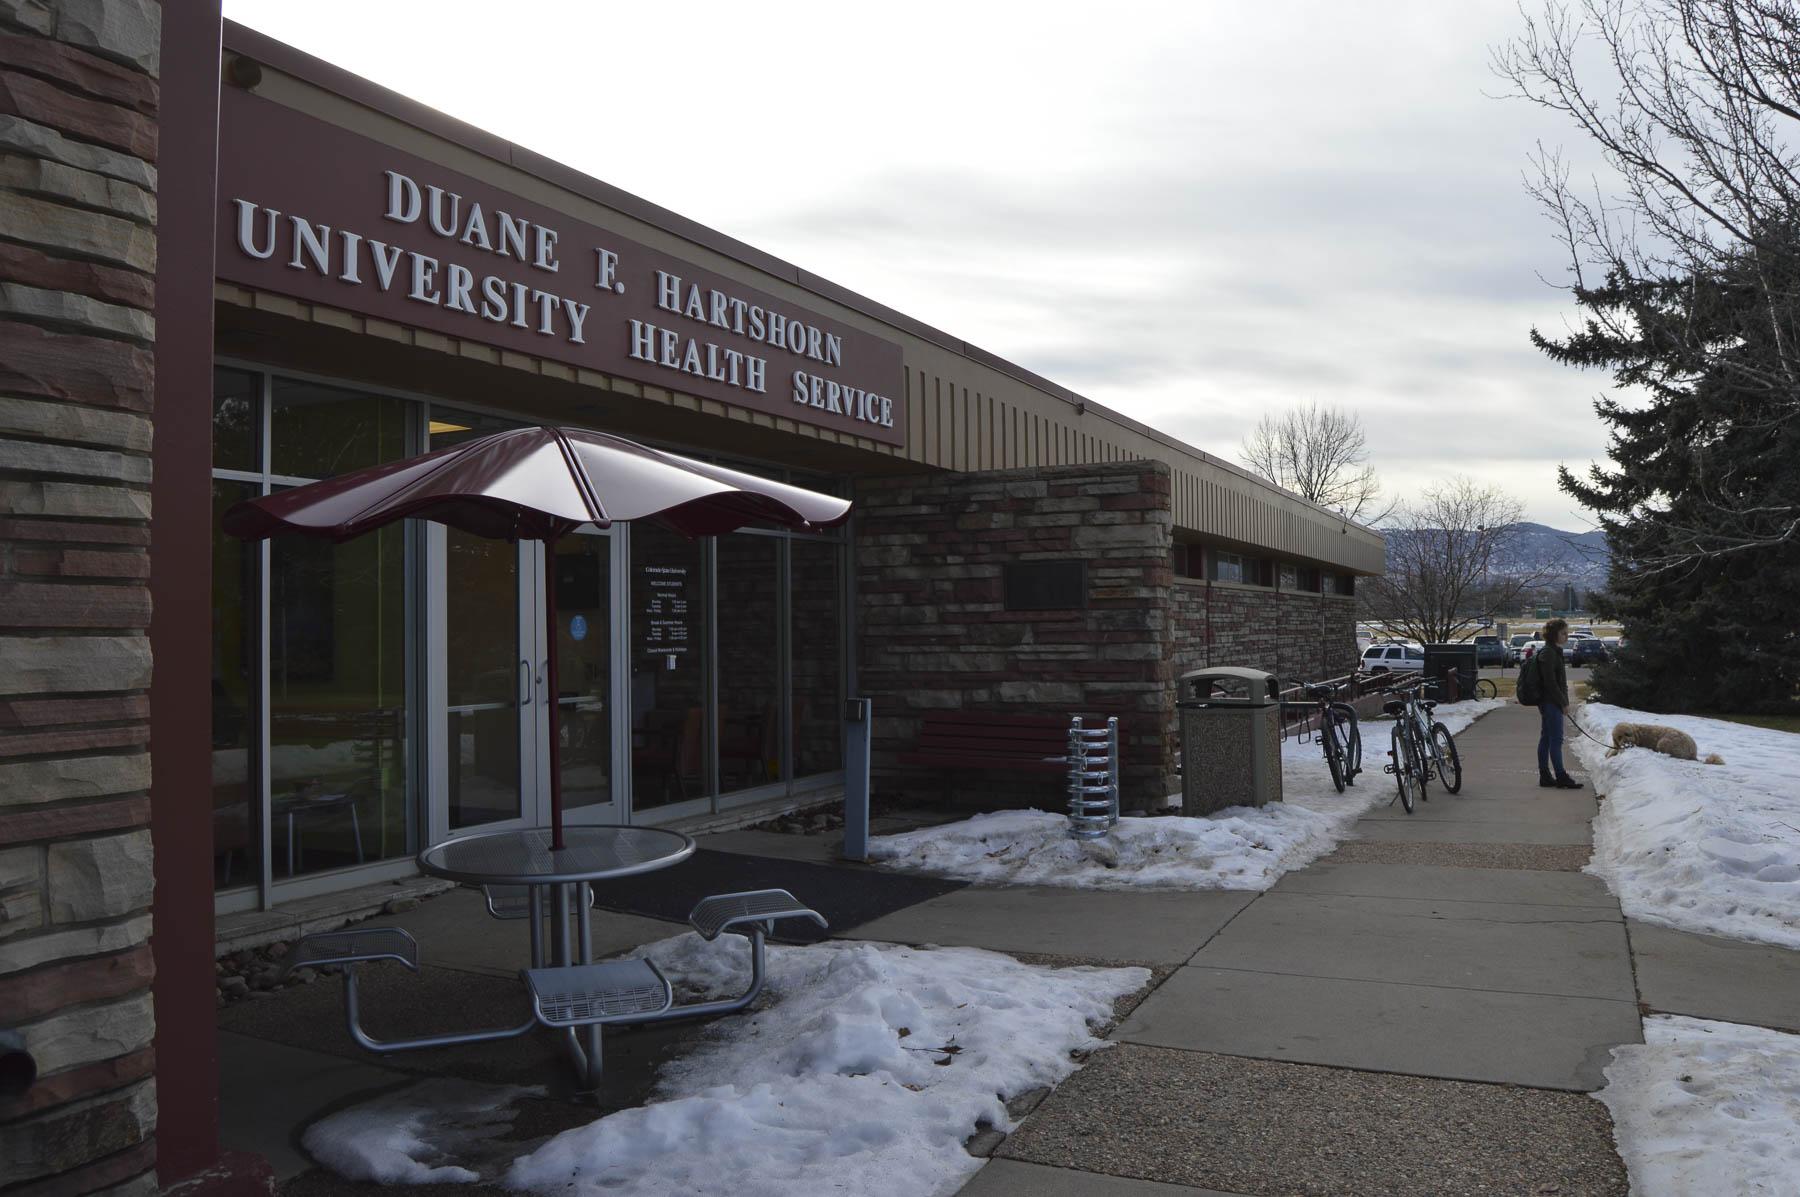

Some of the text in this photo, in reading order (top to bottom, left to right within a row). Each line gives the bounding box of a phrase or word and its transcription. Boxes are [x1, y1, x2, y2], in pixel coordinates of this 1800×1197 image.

[232, 198, 894, 429] UNIVERSITY HEALTH SERVICE
[383, 169, 843, 368] DUANE F. HARTSHORN
